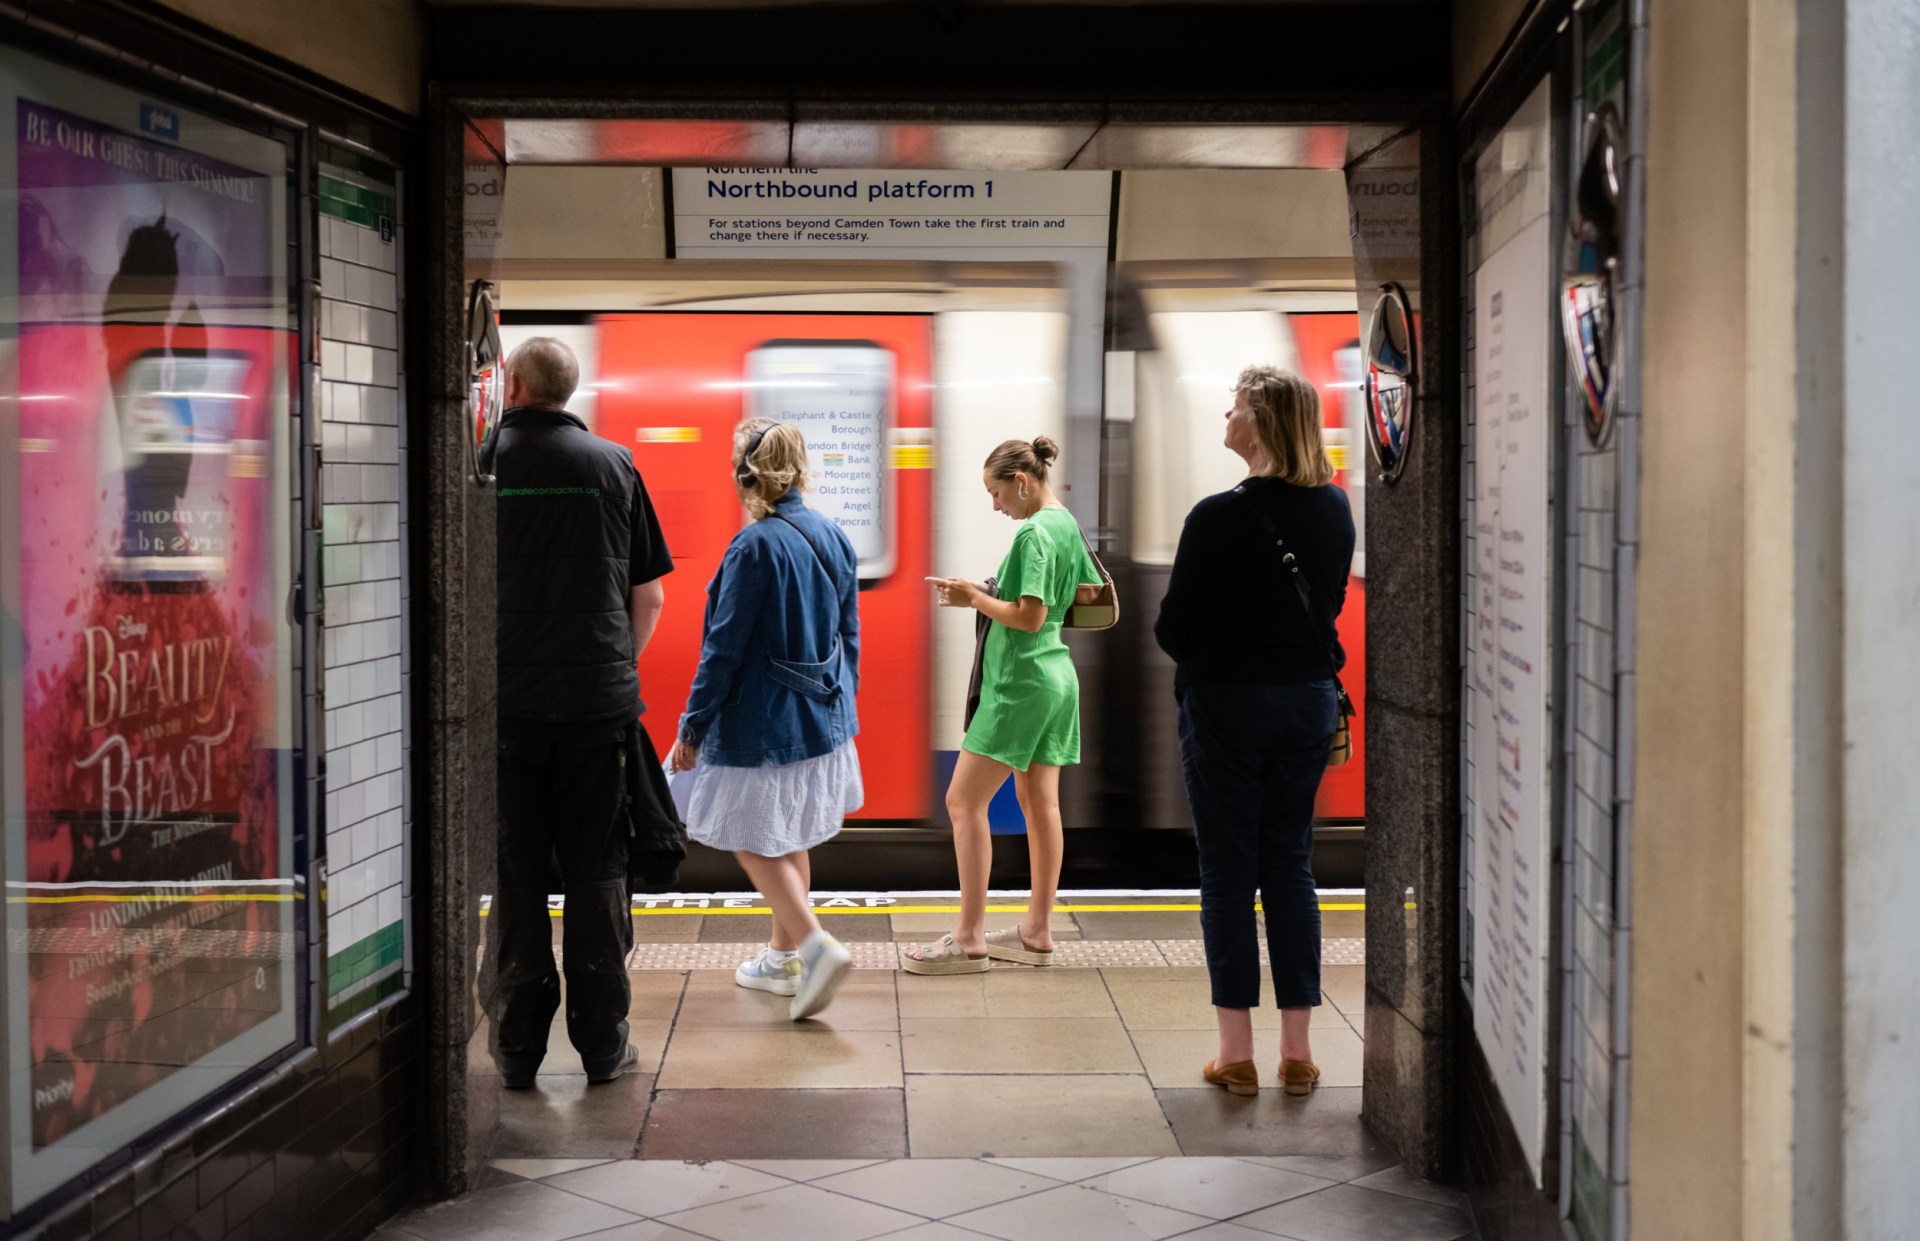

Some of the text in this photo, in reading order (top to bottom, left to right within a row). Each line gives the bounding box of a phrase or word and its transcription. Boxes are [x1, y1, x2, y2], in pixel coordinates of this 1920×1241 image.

[26, 110, 50, 147] BE
[57, 120, 95, 159] OUR
[100, 135, 150, 173] GUEST
[154, 151, 188, 182] THIS
[708, 180, 994, 203] Northbound platform 1
[709, 218, 1066, 231] For stations beyond Camden Town take the first train and
[709, 230, 870, 243] change there if necessary.
[782, 410, 872, 421] Elephant & Castle
[831, 425, 872, 435] Borough
[807, 441, 872, 452] ondon Bridge
[847, 455, 871, 464] Bank
[824, 470, 872, 481] Moorgate
[819, 485, 872, 495] Old Street
[843, 501, 871, 511] Angel
[834, 517, 872, 527] Pancras
[84, 625, 232, 730] BEAUTY
[74, 704, 235, 847] BEAST
[636, 898, 897, 908] THE AP
[90, 892, 151, 937] LONDON
